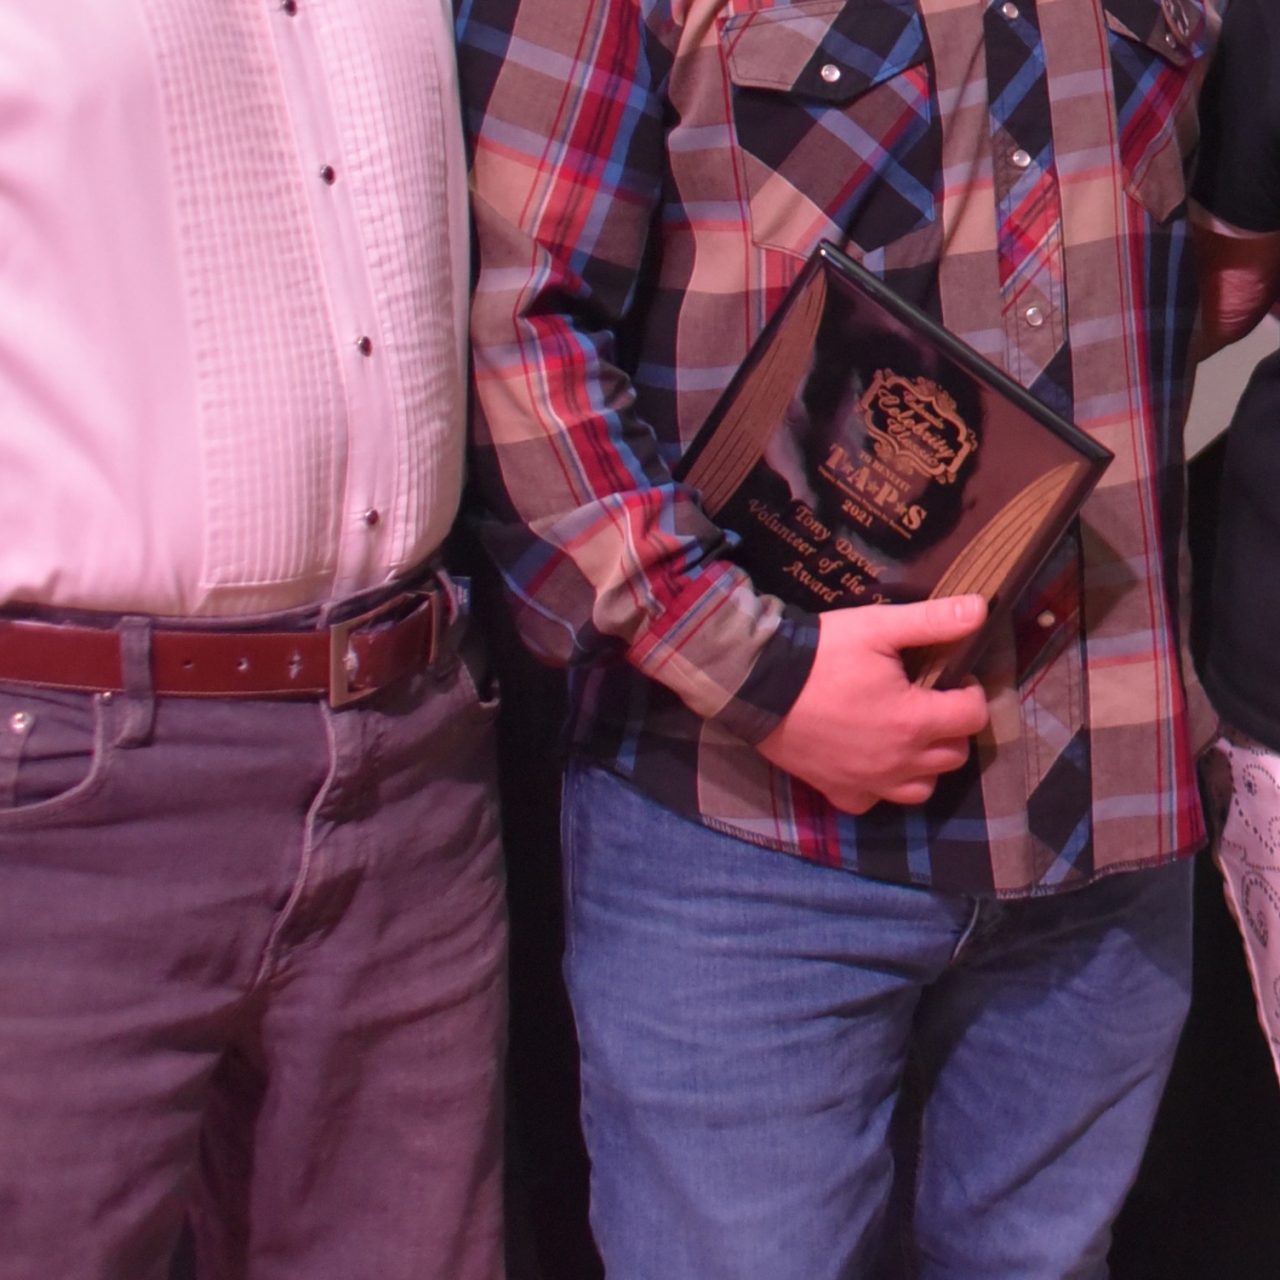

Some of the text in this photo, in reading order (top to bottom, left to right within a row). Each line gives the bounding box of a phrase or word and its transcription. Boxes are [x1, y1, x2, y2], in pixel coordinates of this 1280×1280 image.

[841, 498, 873, 527] 2021
[749, 498, 866, 595] Volunteer of the
[795, 505, 887, 578] Tony David
[782, 561, 844, 603] Award
